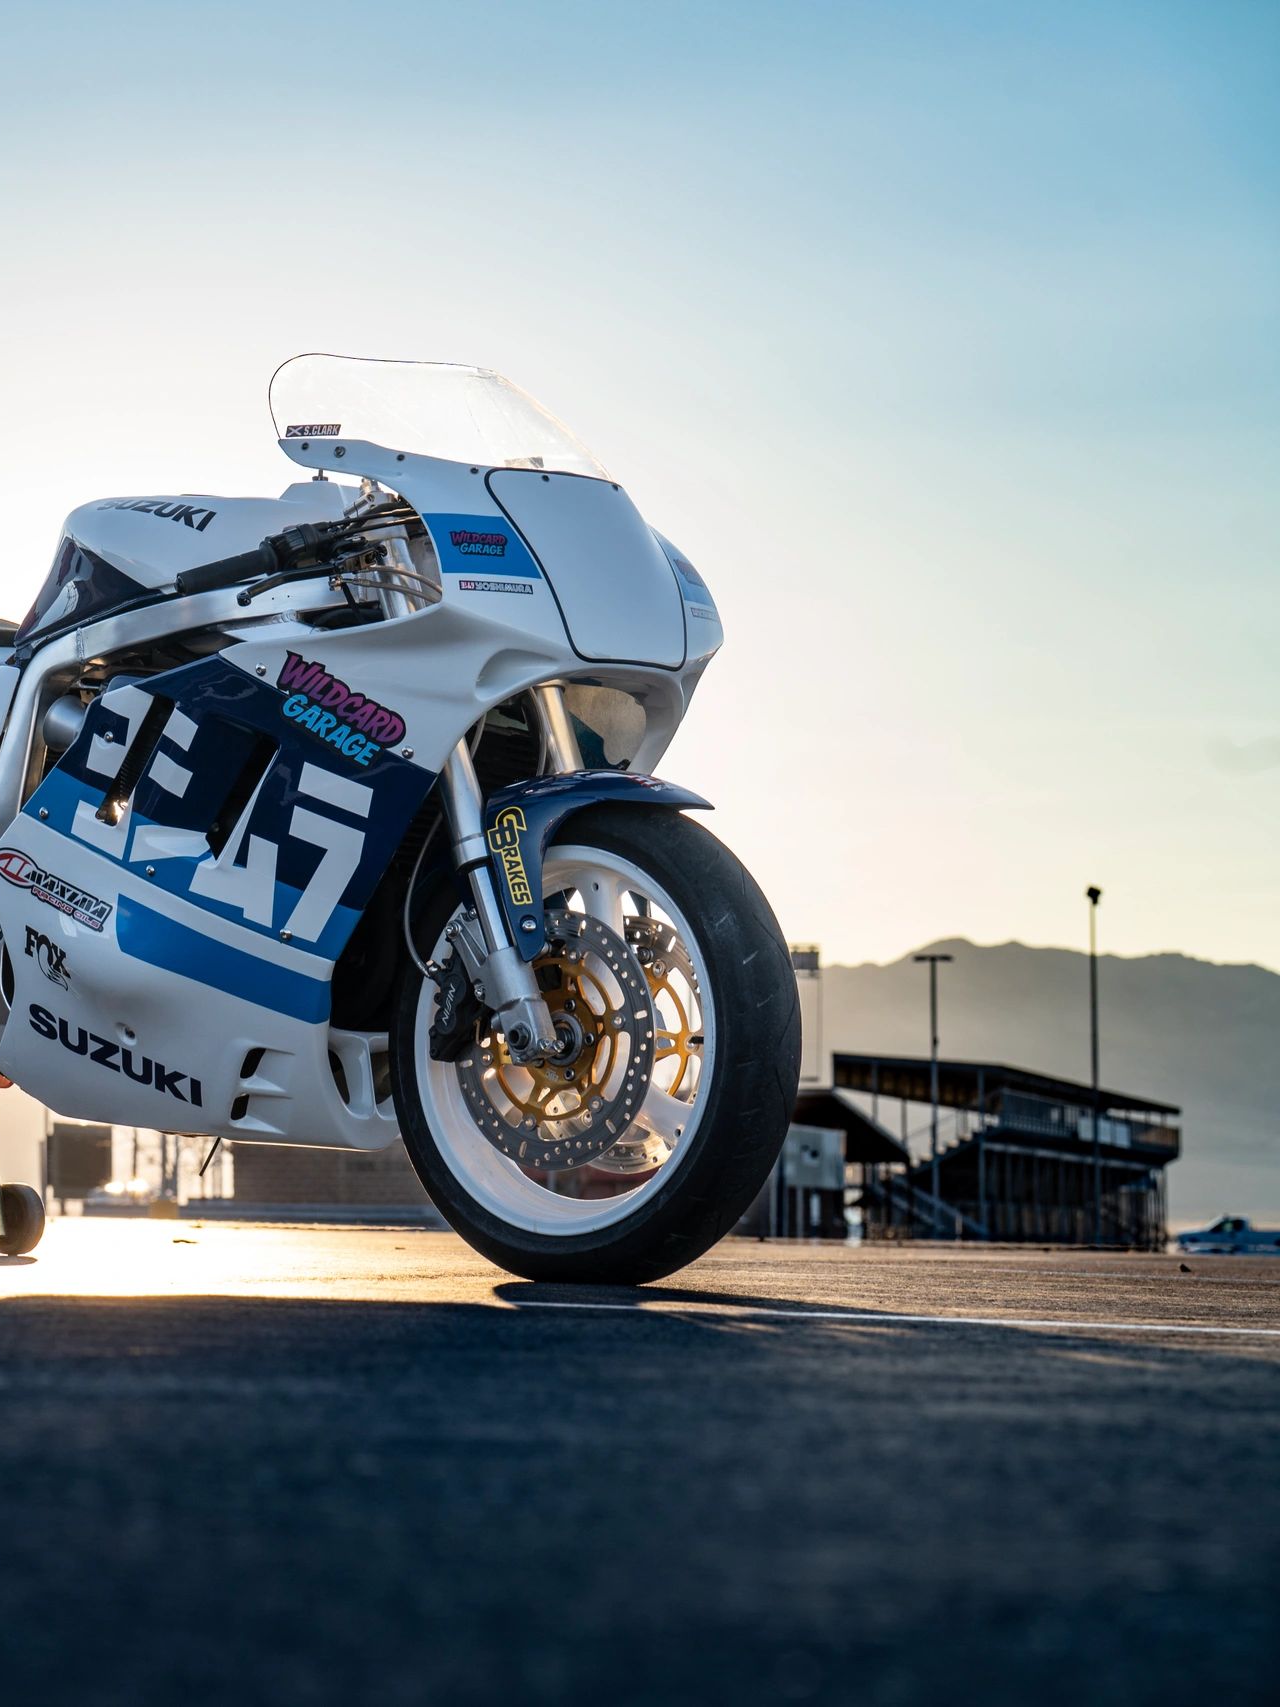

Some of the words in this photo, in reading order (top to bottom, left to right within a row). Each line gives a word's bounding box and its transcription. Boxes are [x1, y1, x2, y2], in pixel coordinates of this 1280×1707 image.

[303, 425, 340, 436] S.CLARK
[97, 499, 217, 532] SUZUKI
[451, 531, 506, 545] WILDCARD
[460, 543, 504, 555] GARAGE
[475, 582, 532, 593] YOSHIMURA
[278, 651, 405, 744] WILDCARD
[282, 694, 381, 766] GARAGE
[32, 886, 73, 915] RACING
[73, 909, 101, 930] OILS
[25, 925, 71, 991] FOX
[29, 1003, 203, 1108] SUZUKI
